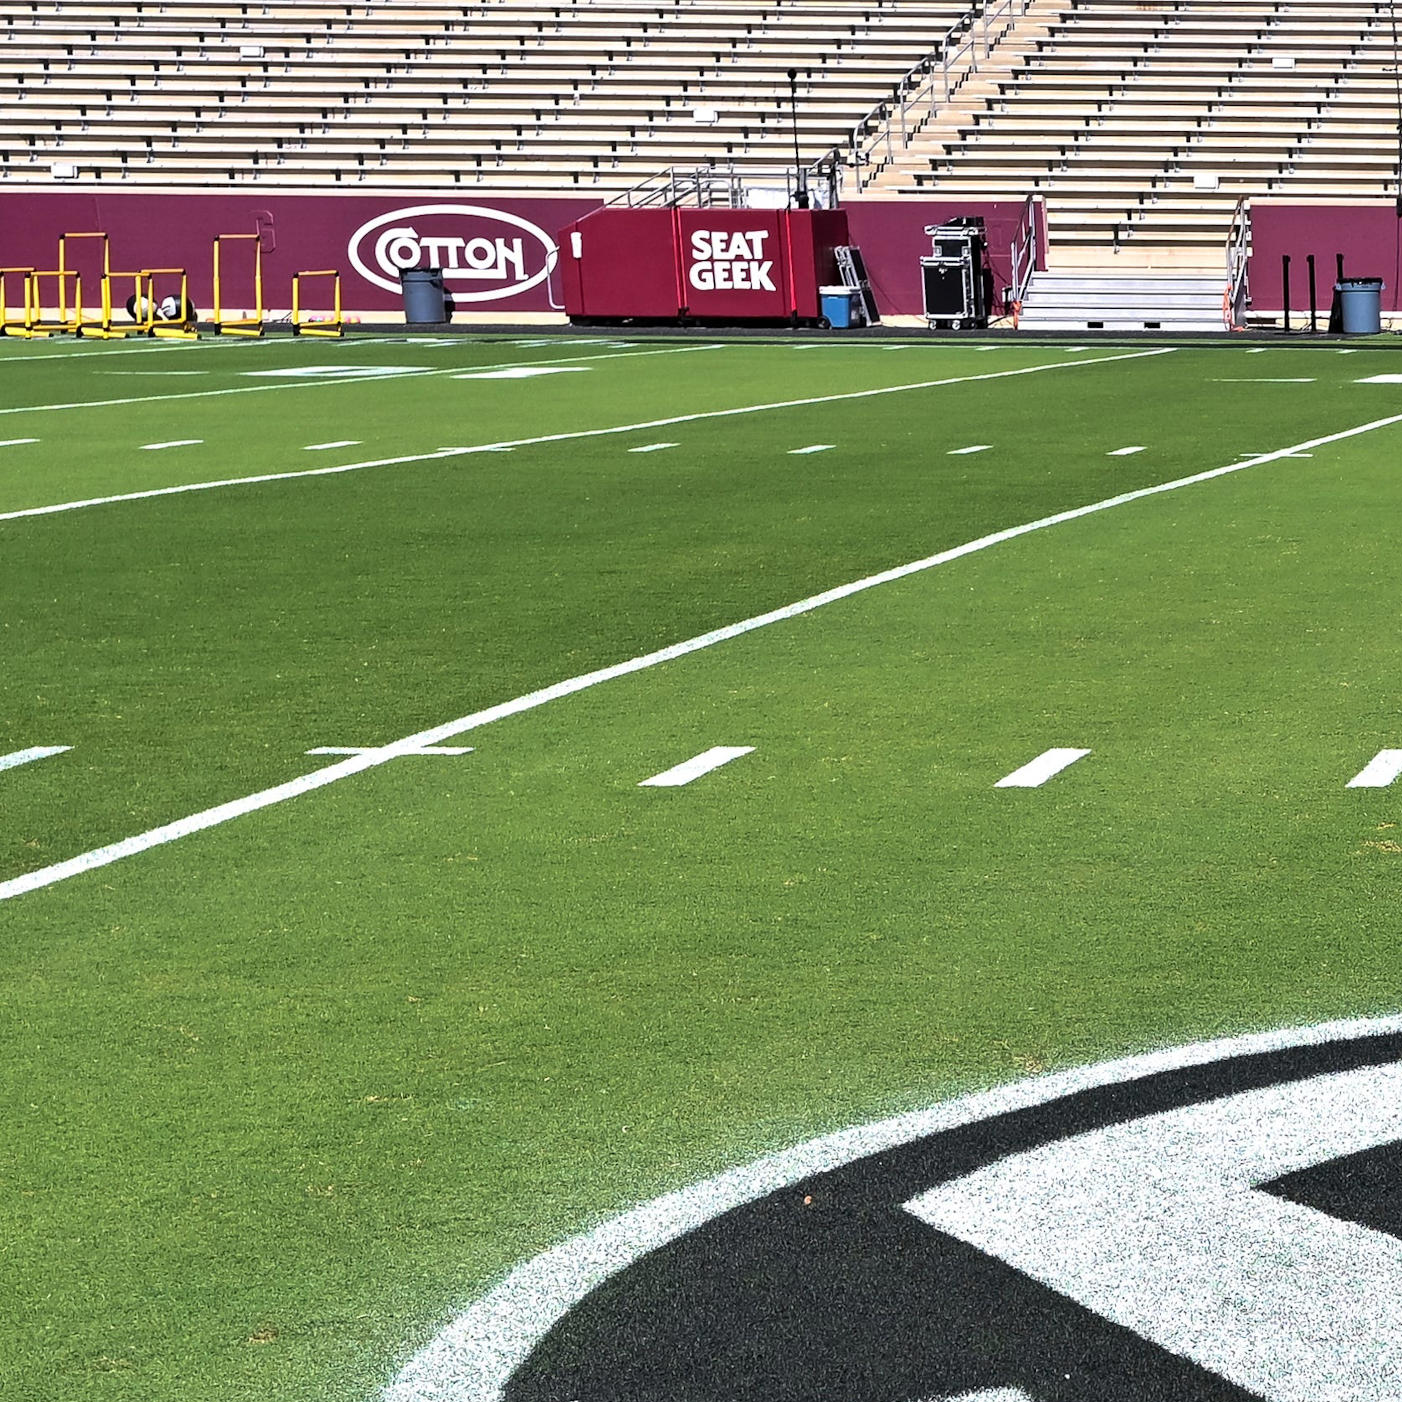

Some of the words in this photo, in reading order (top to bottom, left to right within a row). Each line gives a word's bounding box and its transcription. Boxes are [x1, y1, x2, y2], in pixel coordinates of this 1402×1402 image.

[375, 227, 530, 281] COTTON
[691, 230, 769, 261] SEAT
[689, 261, 777, 292] GEEK
